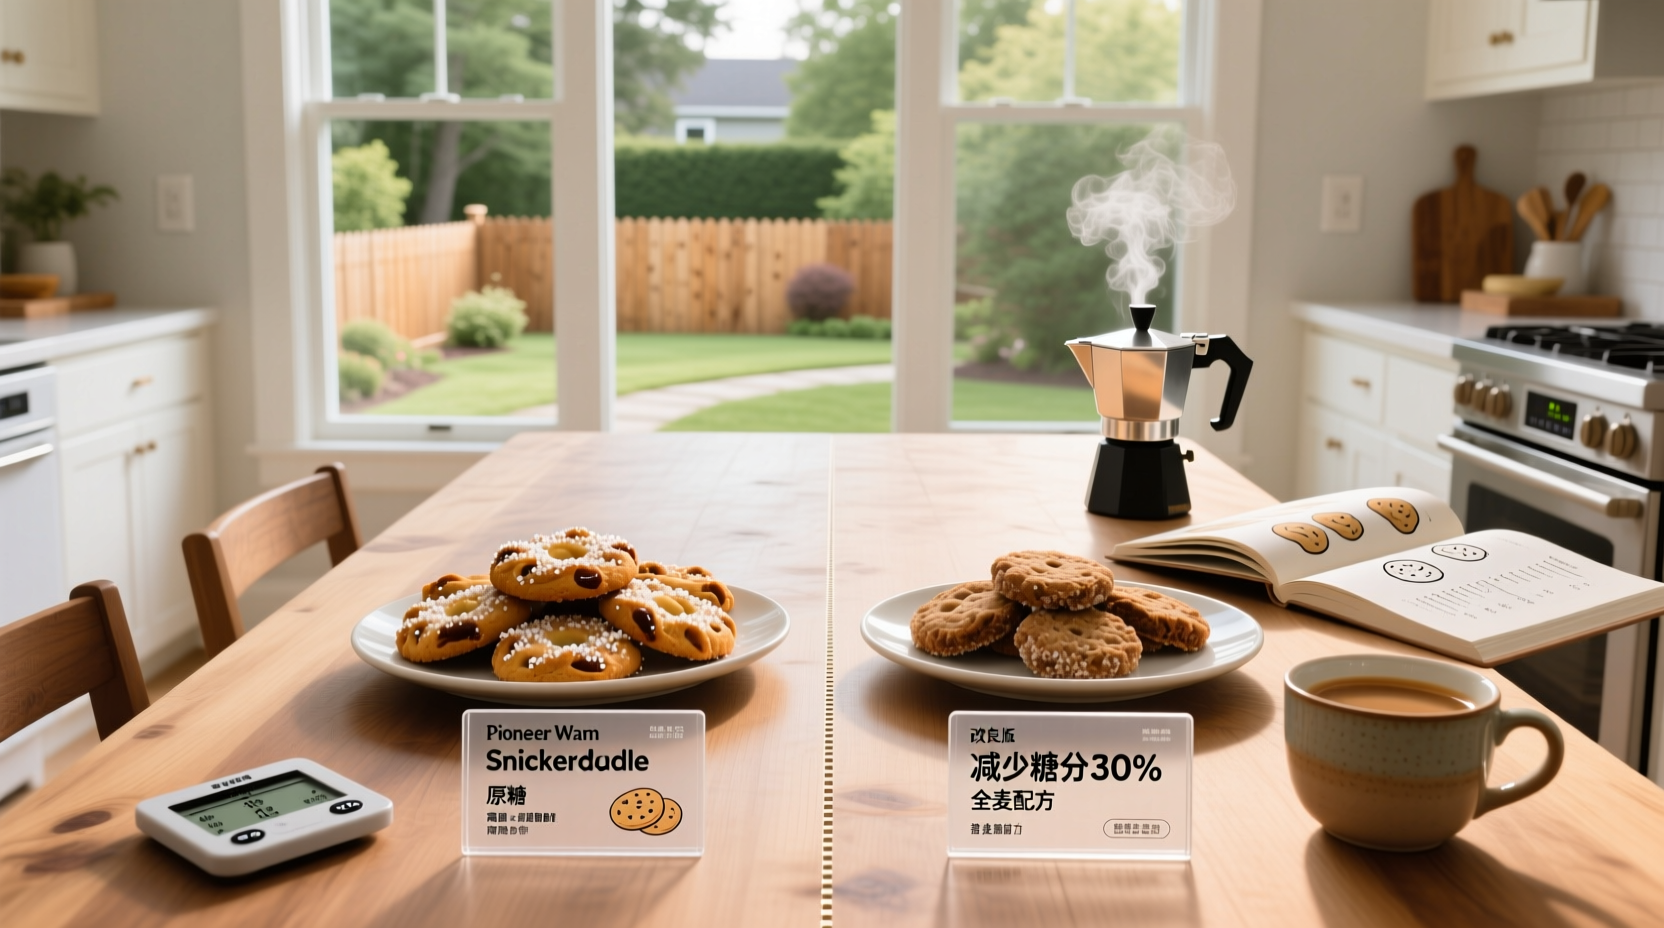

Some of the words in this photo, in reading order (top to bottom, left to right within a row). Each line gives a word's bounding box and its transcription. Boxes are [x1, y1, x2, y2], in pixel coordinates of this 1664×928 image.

[486, 724, 552, 741] Pioneer
[554, 724, 600, 741] Wam
[970, 750, 1162, 783] 减少糖分30%
[486, 784, 527, 806] 原糖
[970, 788, 1055, 811] 全麦配方
